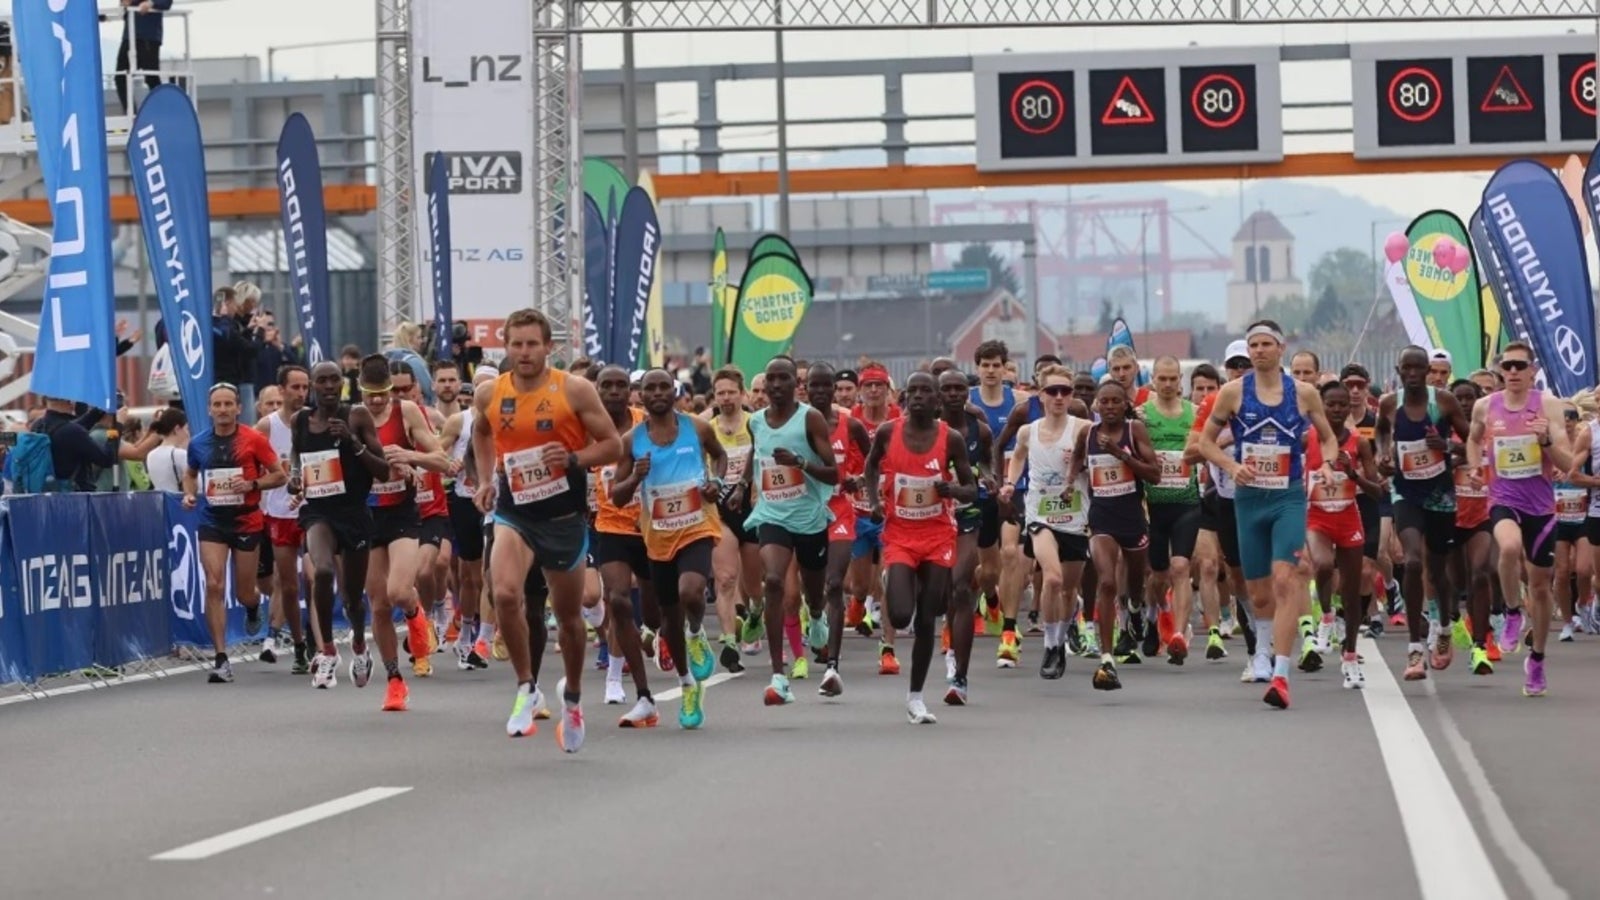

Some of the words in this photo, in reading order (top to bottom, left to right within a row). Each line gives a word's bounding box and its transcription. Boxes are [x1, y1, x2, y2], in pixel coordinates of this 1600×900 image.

[1399, 83, 1430, 105] 80
[1582, 76, 1597, 101] 8
[1021, 97, 1053, 119] 80
[1201, 89, 1234, 113] 80
[445, 156, 516, 177] IVA
[448, 177, 516, 190] PORT
[424, 248, 481, 262] LNZ
[487, 248, 523, 262] AG
[756, 306, 793, 323] BOMBE
[1414, 454, 1429, 466] 25
[1509, 452, 1526, 463] 2A
[314, 469, 321, 480] 7
[518, 466, 552, 484] 1794
[771, 474, 785, 485] 28
[1104, 470, 1118, 481] 18
[517, 483, 565, 502] Oberbank
[915, 493, 923, 504] 8
[667, 500, 682, 513] 27
